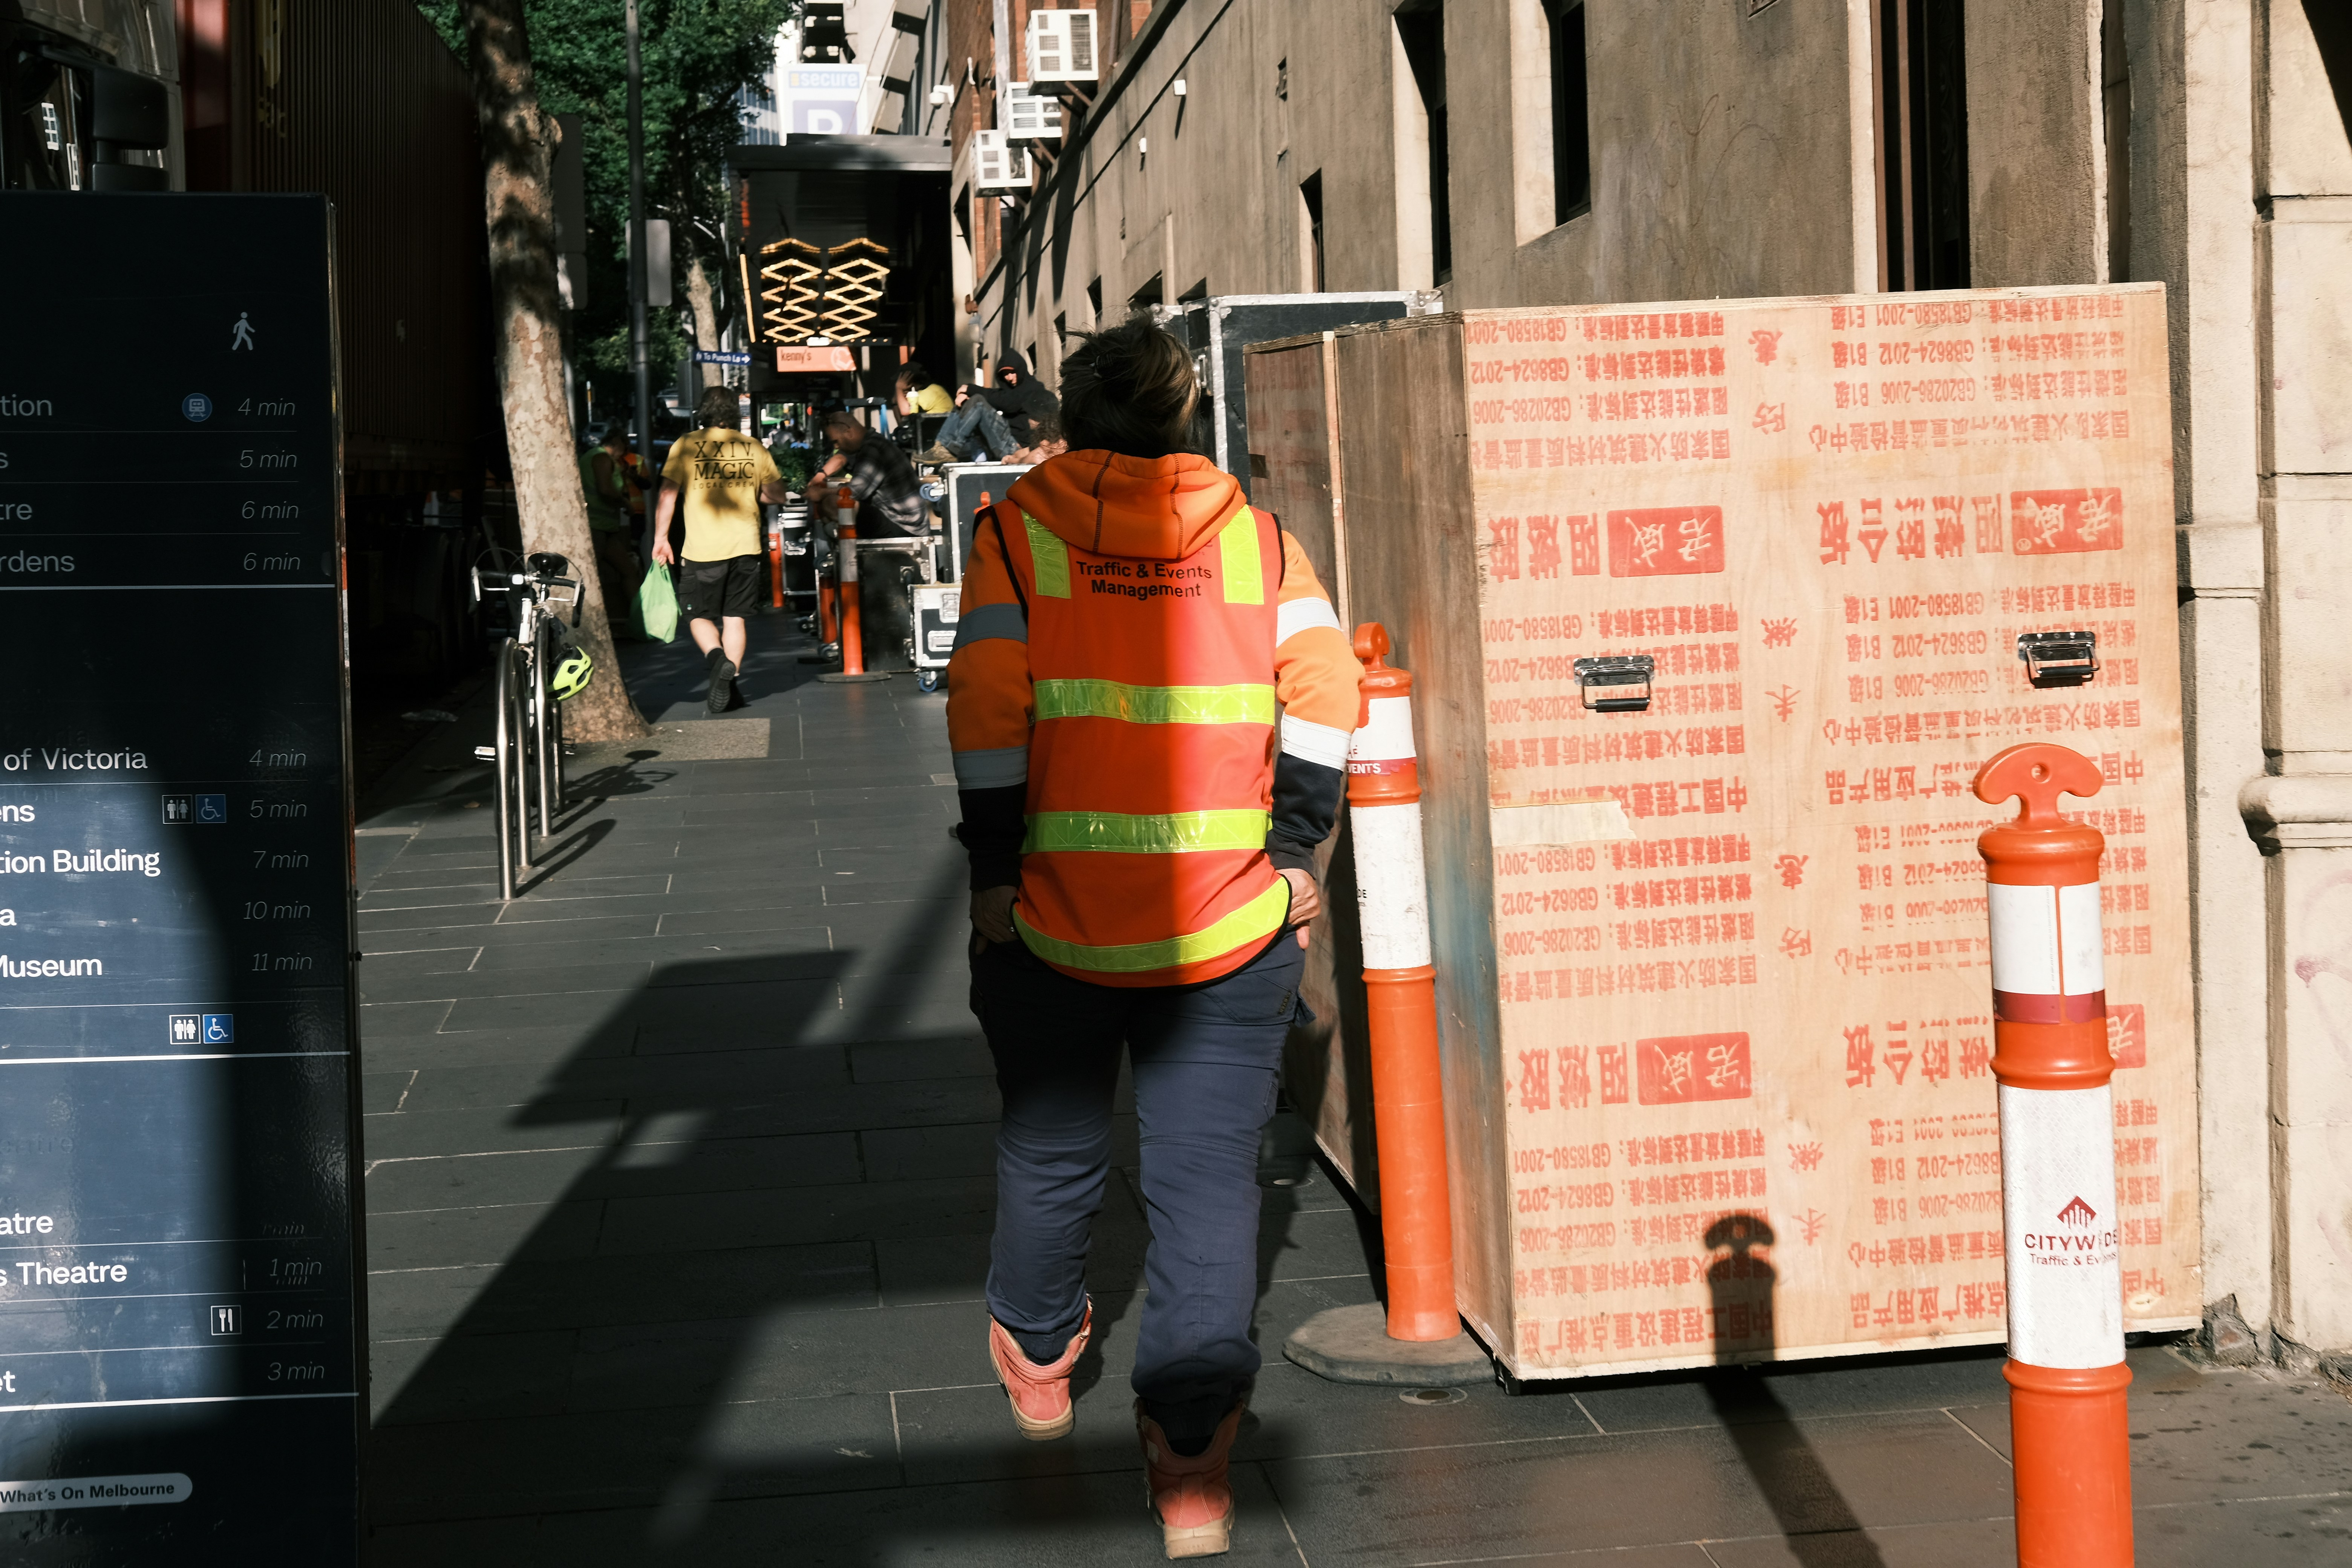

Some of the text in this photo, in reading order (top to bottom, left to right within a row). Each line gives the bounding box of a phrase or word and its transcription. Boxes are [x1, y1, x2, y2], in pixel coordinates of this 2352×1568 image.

[800, 73, 858, 86] secure
[781, 349, 812, 364] kenny's
[237, 398, 296, 416] 4 min
[240, 450, 297, 468] 5 min
[694, 462, 754, 481] MAGIC
[242, 501, 299, 519] 6 min
[243, 552, 300, 571] 6 min
[1076, 561, 1212, 579] Traffic & Events
[1091, 579, 1202, 601] Management
[3, 747, 148, 771] of Victoria
[249, 749, 306, 767] 4 min
[250, 799, 307, 818] 5 min
[53, 848, 161, 877] Building
[253, 850, 309, 868] 7 min
[243, 900, 311, 919] 10 min
[252, 952, 312, 971] 11 min
[1506, 1042, 1628, 1113] 阻燃胶
[15, 1261, 127, 1285] Theatre
[270, 1257, 322, 1276] 1 min
[266, 1309, 323, 1329] 2 min
[268, 1361, 325, 1381] 3 min
[0, 1484, 175, 1504] What's On Melbourne
